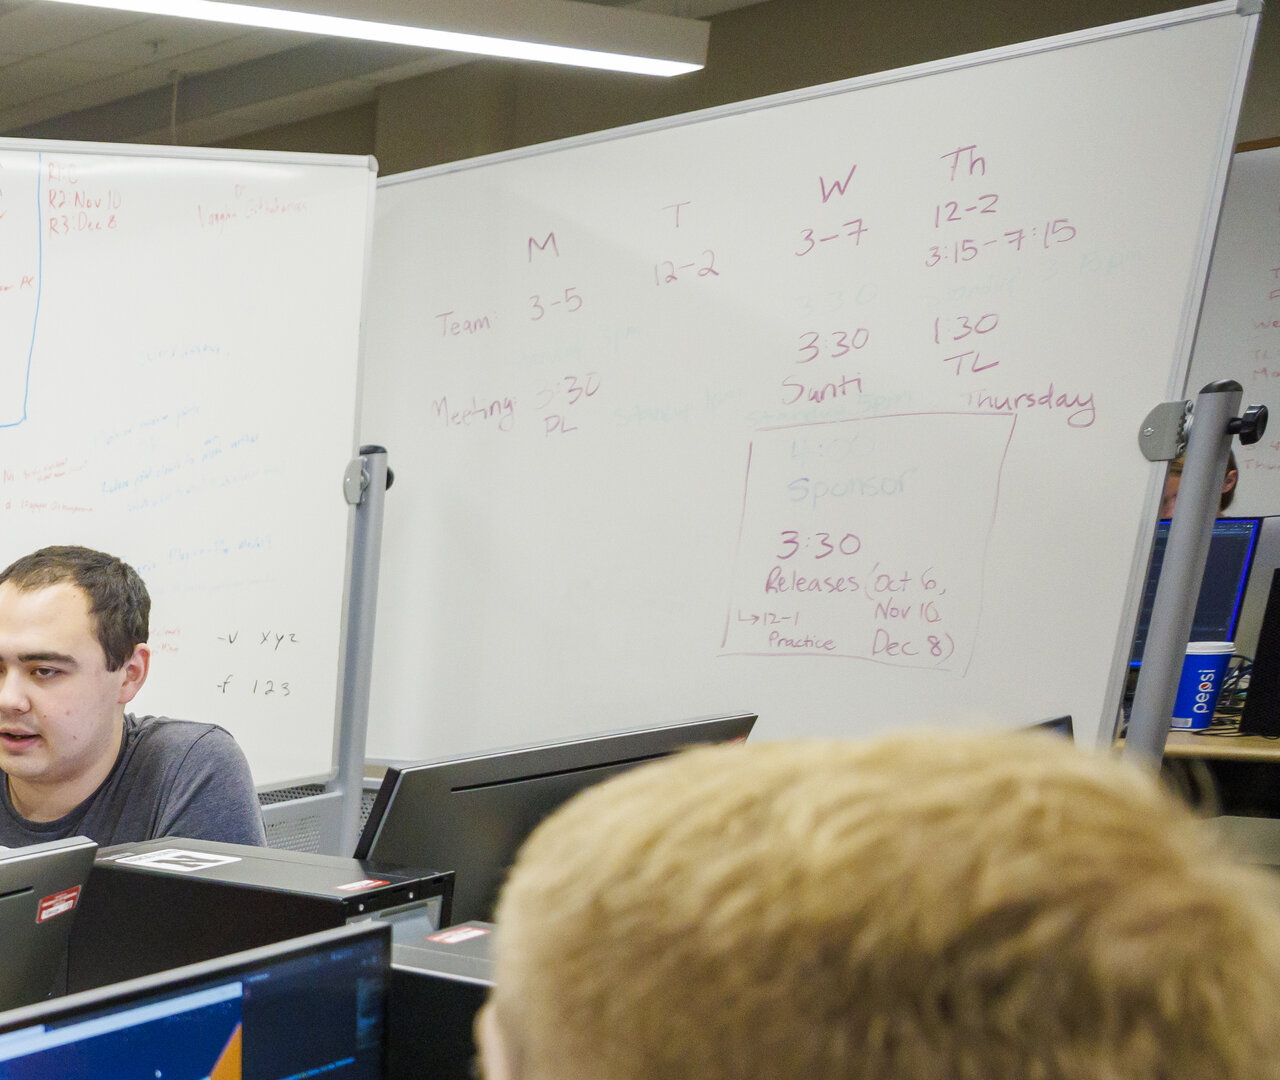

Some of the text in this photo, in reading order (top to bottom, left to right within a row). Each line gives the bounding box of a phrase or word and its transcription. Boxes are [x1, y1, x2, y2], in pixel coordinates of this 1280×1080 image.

[940, 145, 986, 182] Th
[820, 164, 856, 203] W
[662, 201, 694, 229] T
[528, 231, 559, 263] M
[529, 287, 583, 322] 3-5
[654, 249, 720, 287] 12-2
[795, 217, 869, 257] 3-7
[935, 193, 1000, 228] 12-2
[796, 328, 870, 364] 3:30
[944, 350, 1000, 376] TL
[966, 382, 1096, 429] Thursday
[776, 530, 862, 560] 3:30
[765, 566, 861, 594] Releases
[875, 603, 913, 621] Nov
[768, 634, 837, 651] Practice
[872, 628, 919, 656] Dec
[1193, 669, 1216, 714] pepsi
